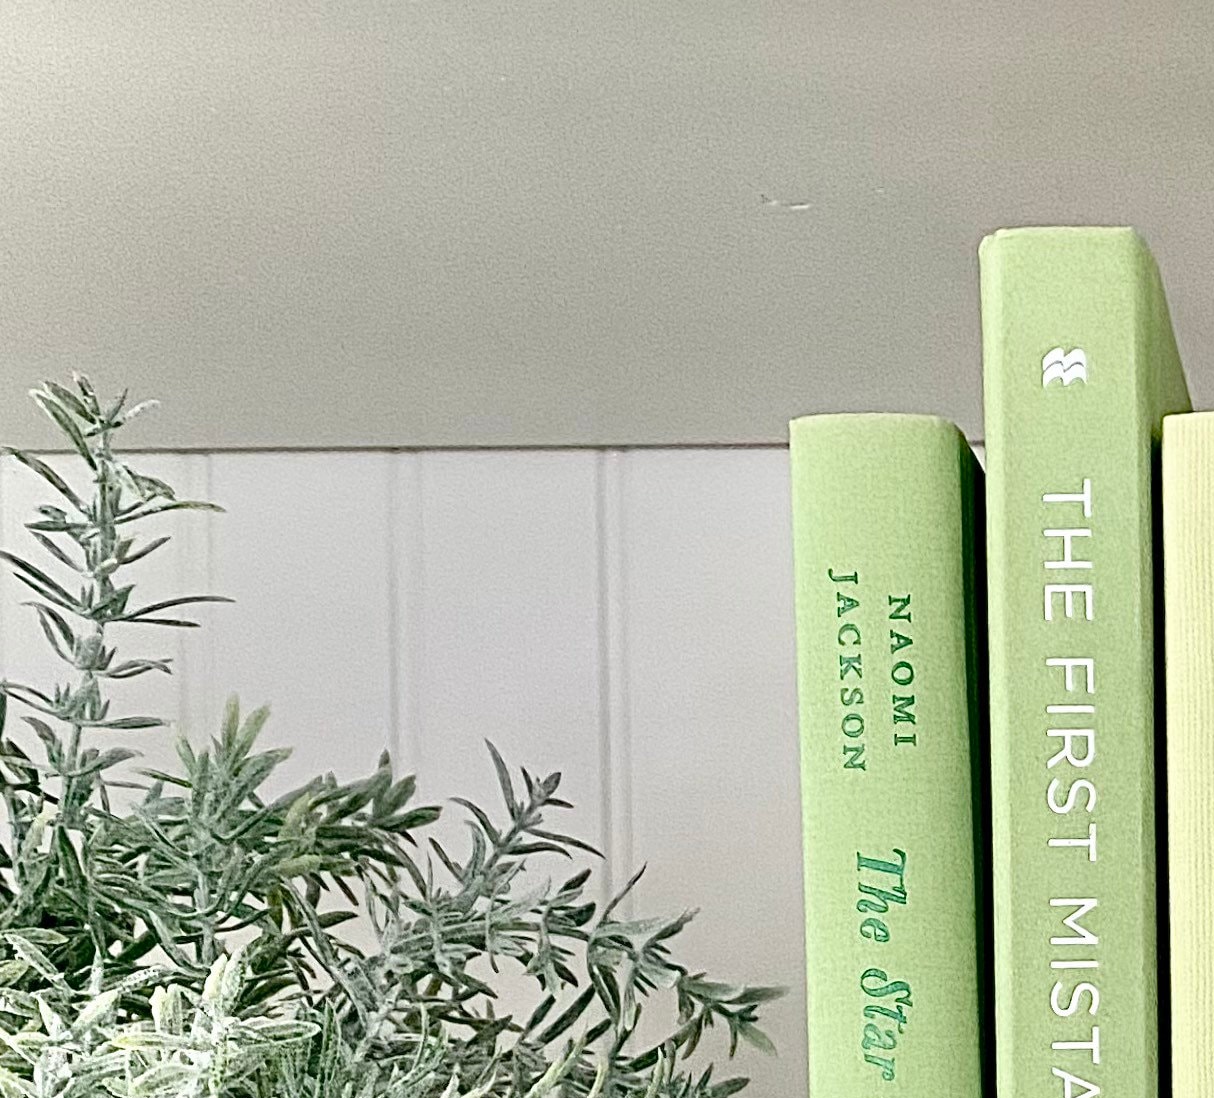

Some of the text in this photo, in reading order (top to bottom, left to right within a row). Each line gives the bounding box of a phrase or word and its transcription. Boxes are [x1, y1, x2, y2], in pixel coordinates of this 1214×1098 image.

[1042, 479, 1092, 621] THE
[828, 569, 866, 772] JACKSON
[888, 594, 917, 747] NAOMI
[1045, 656, 1096, 862] FIRST
[856, 848, 907, 944] The
[860, 967, 914, 1080] Star
